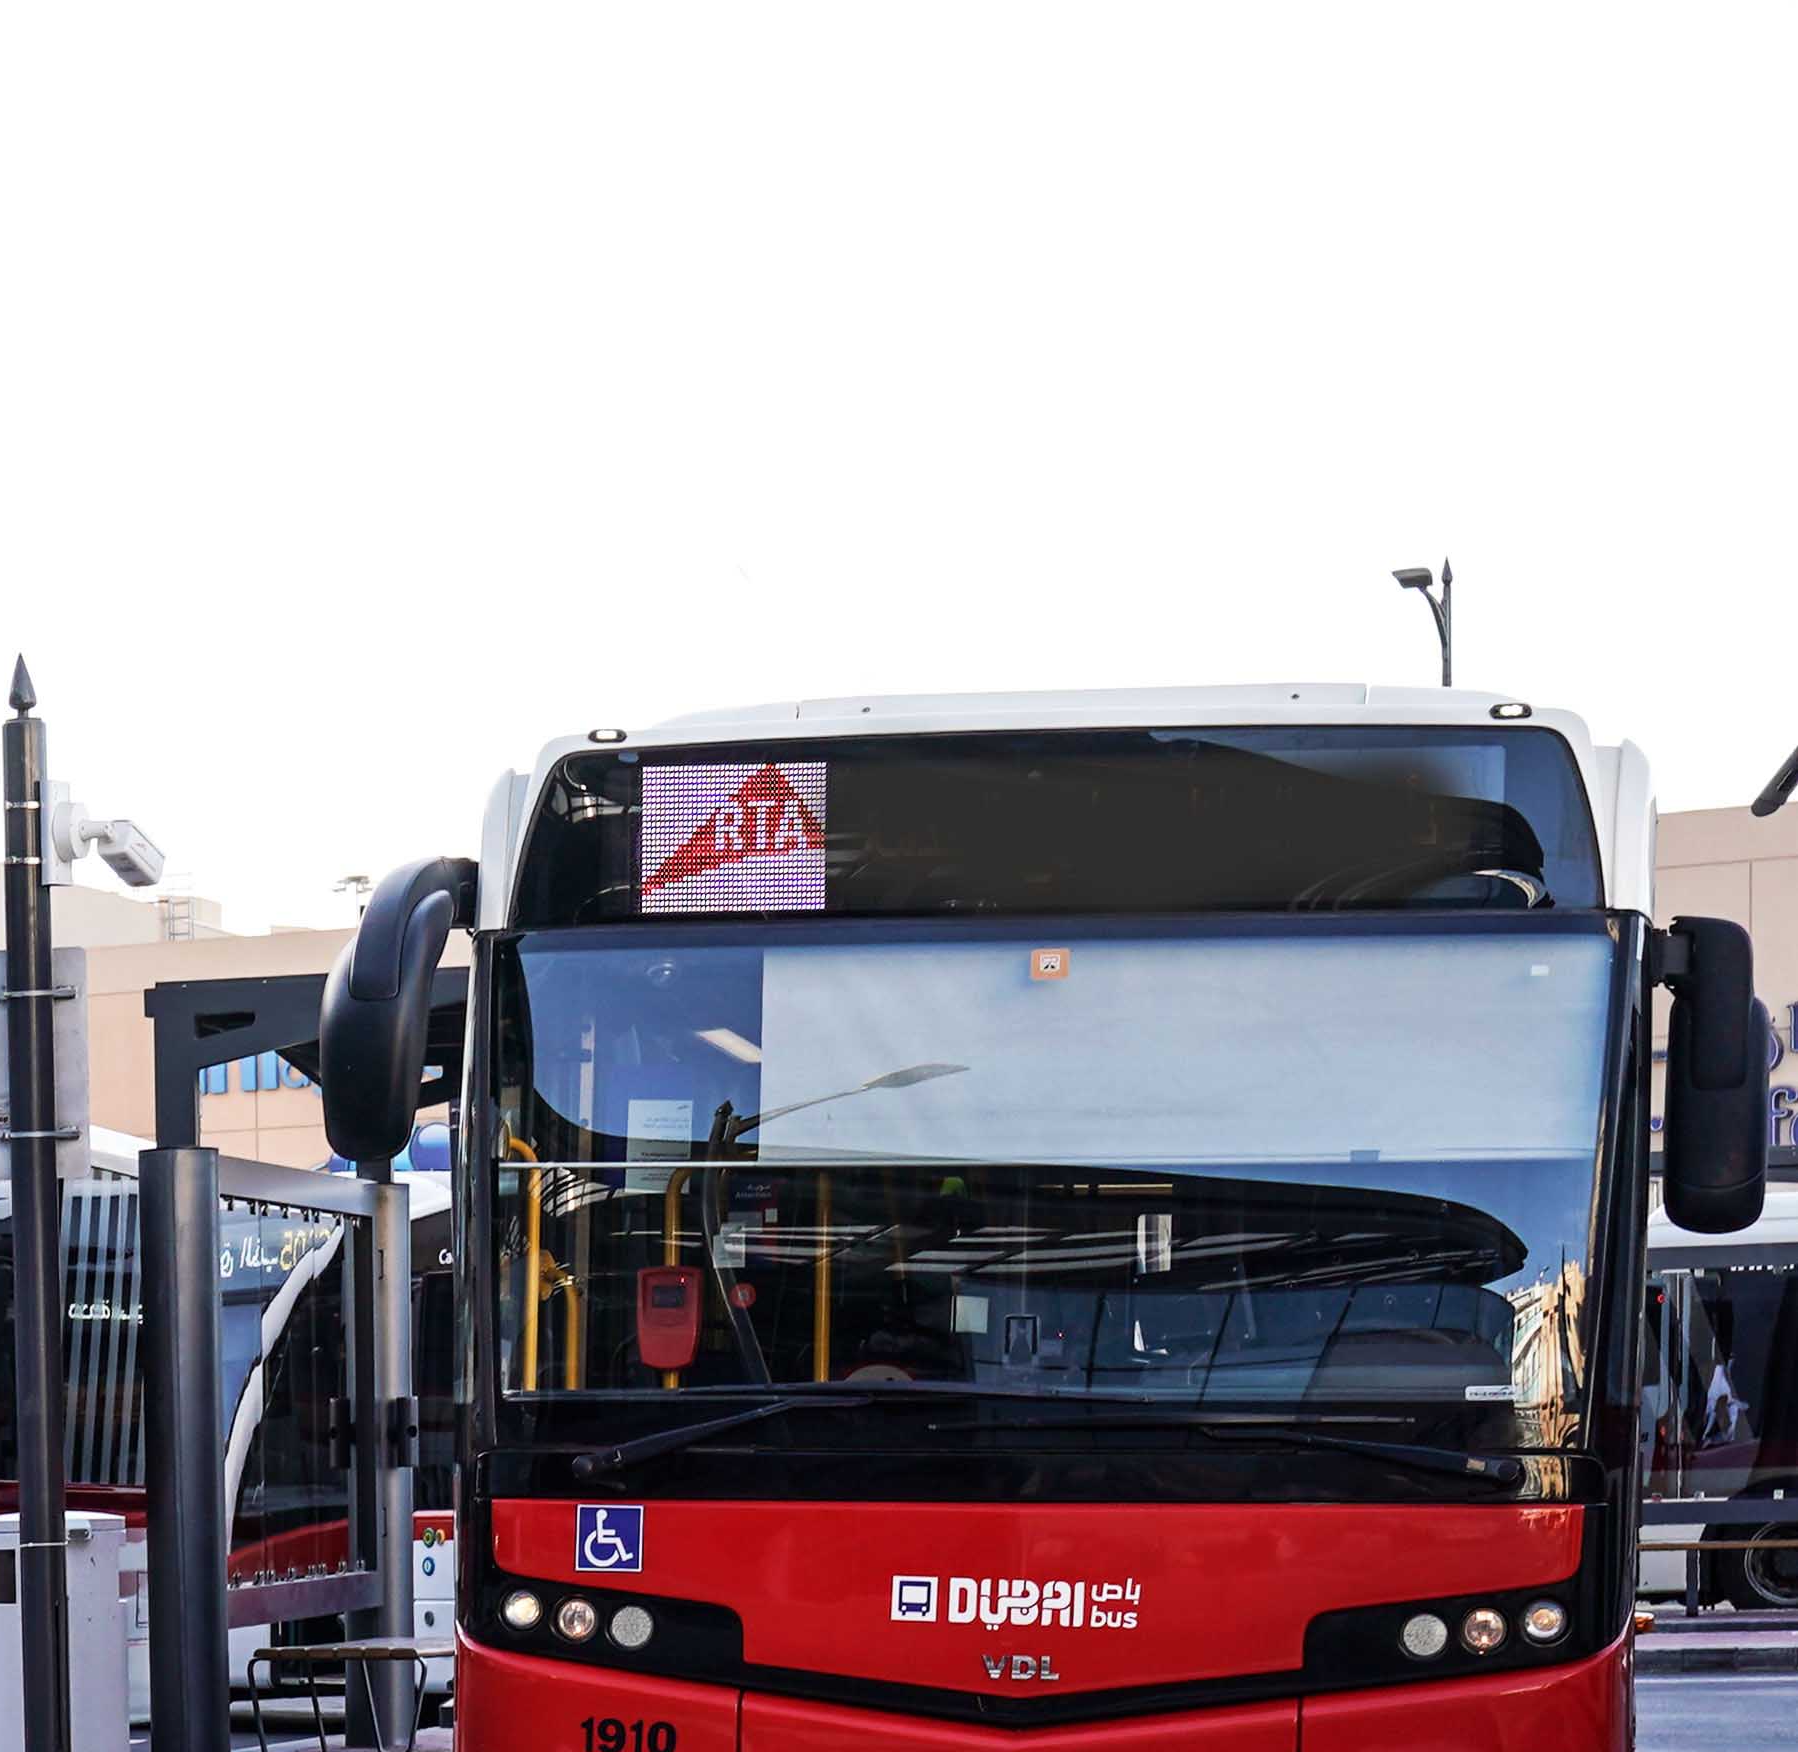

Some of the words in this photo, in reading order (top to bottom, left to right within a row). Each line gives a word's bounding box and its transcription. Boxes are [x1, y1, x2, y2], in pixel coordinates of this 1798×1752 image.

[715, 799, 807, 851] RTA
[947, 1576, 1085, 1630] DUBAI
[1090, 1577, 1141, 1606] باص
[1090, 1605, 1138, 1629] bus
[981, 1654, 1060, 1680] VDL
